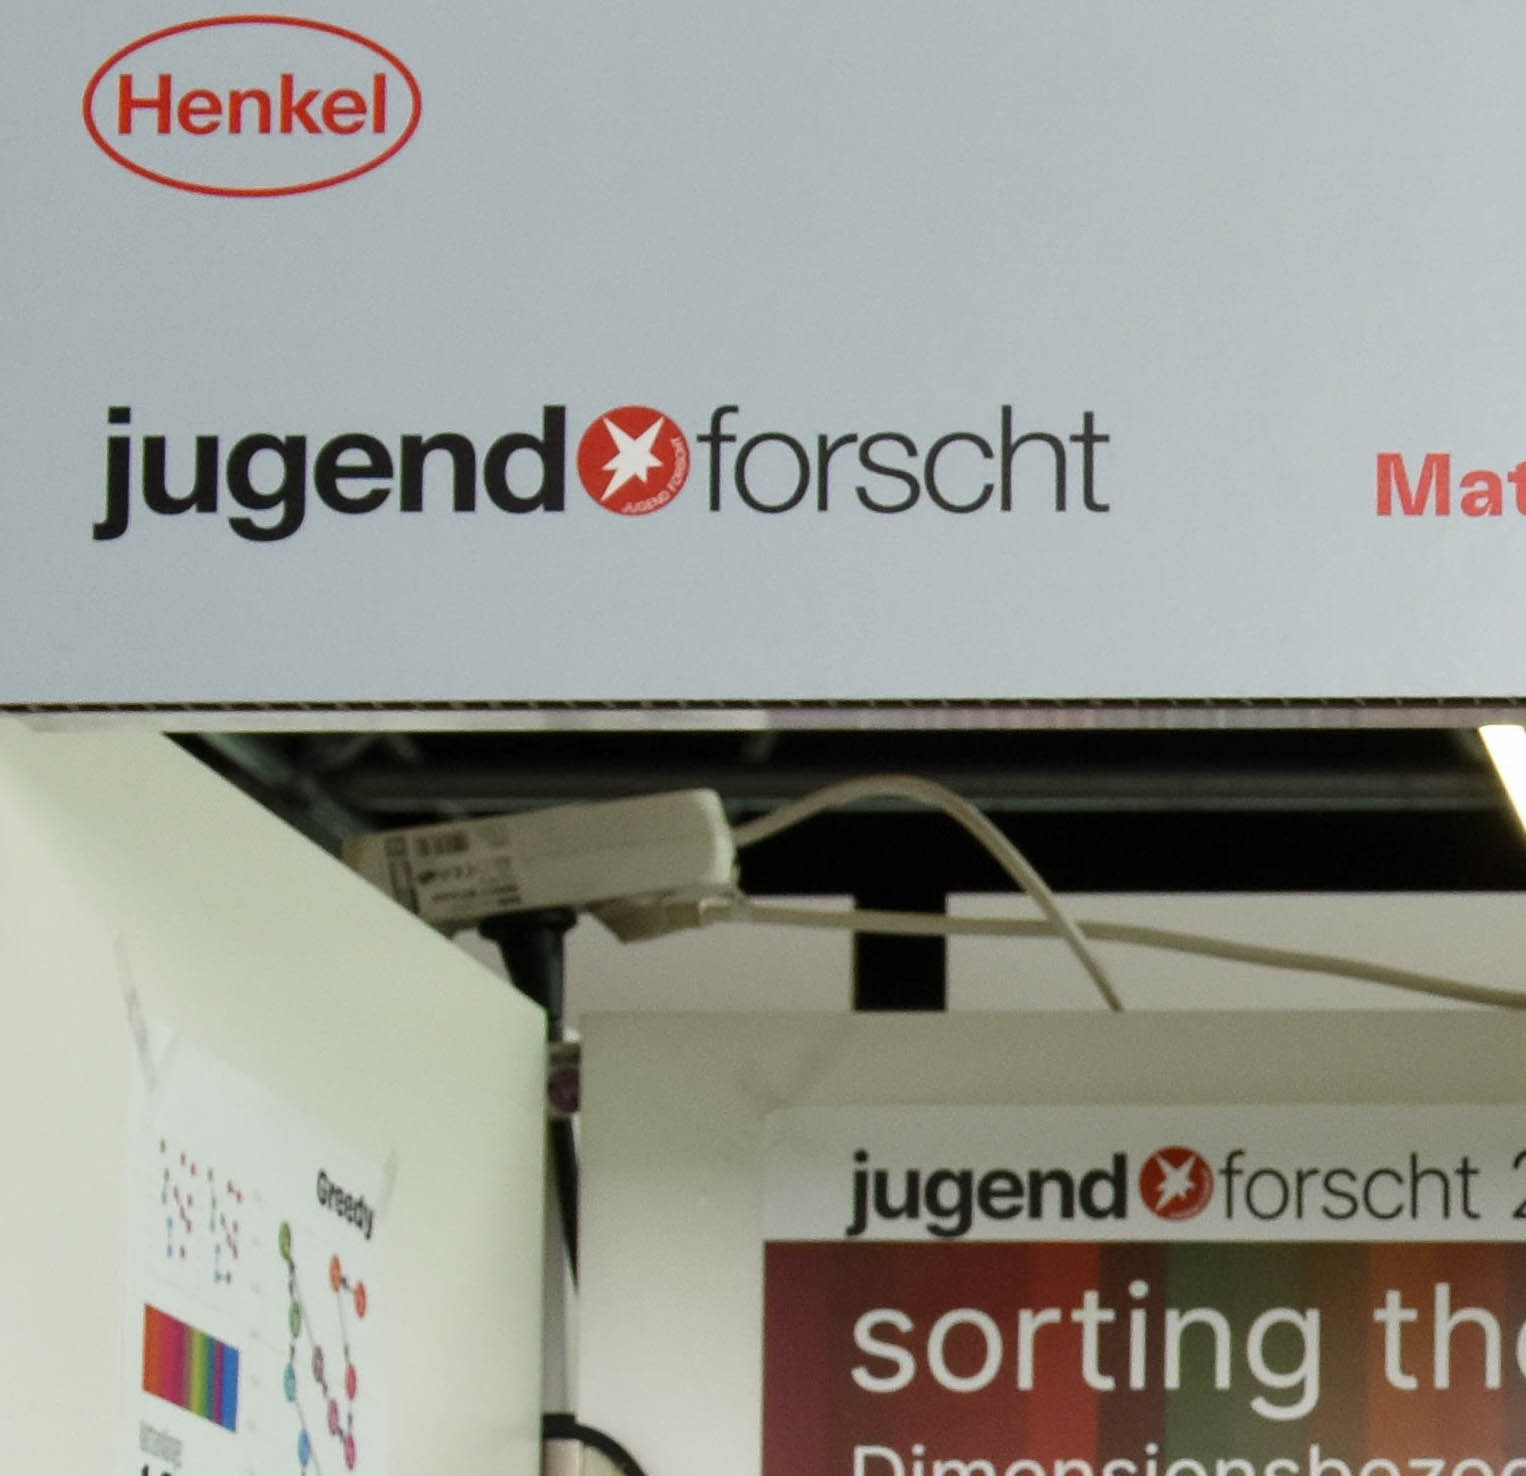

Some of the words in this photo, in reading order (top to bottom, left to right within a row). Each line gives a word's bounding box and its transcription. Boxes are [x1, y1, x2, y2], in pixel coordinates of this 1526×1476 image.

[116, 72, 389, 136] Henkel
[92, 404, 567, 543] jugend
[696, 404, 1110, 515] forscht
[316, 1169, 376, 1240] Greedy
[845, 1149, 1128, 1241] jugend
[1218, 1148, 1481, 1220] forscht
[851, 1280, 1321, 1421] sorting
